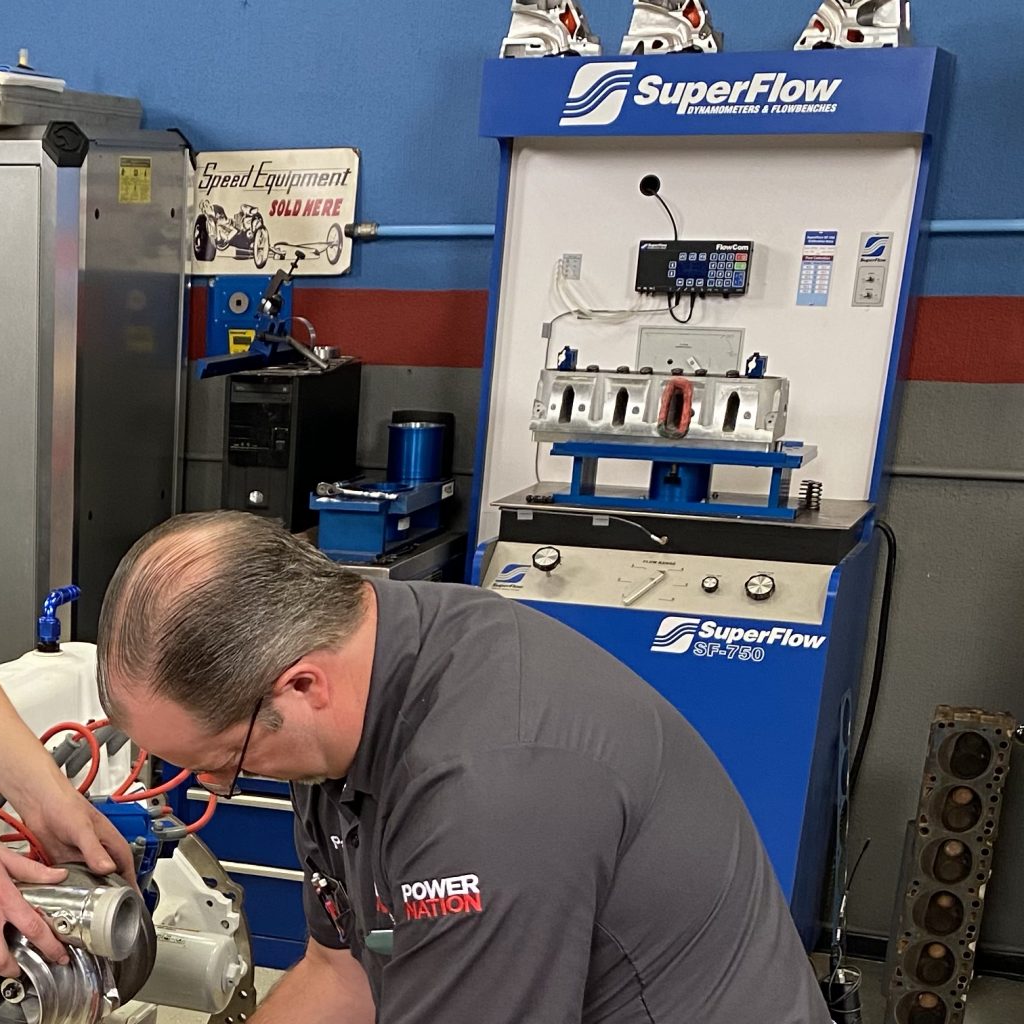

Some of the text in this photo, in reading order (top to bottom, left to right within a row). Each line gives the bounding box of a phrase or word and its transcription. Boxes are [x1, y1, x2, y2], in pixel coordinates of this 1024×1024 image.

[633, 72, 843, 115] SuperFlow
[687, 103, 837, 115] DYNAMOMETERS & FLOWBENCHES
[198, 160, 352, 196] Speed Equipment
[269, 198, 344, 217] SOLD HERE
[716, 243, 749, 251] FlowCom
[698, 620, 827, 649] SuperFlow
[692, 641, 765, 662] SF-750
[401, 873, 480, 903] POWER
[405, 893, 483, 921] NATION
